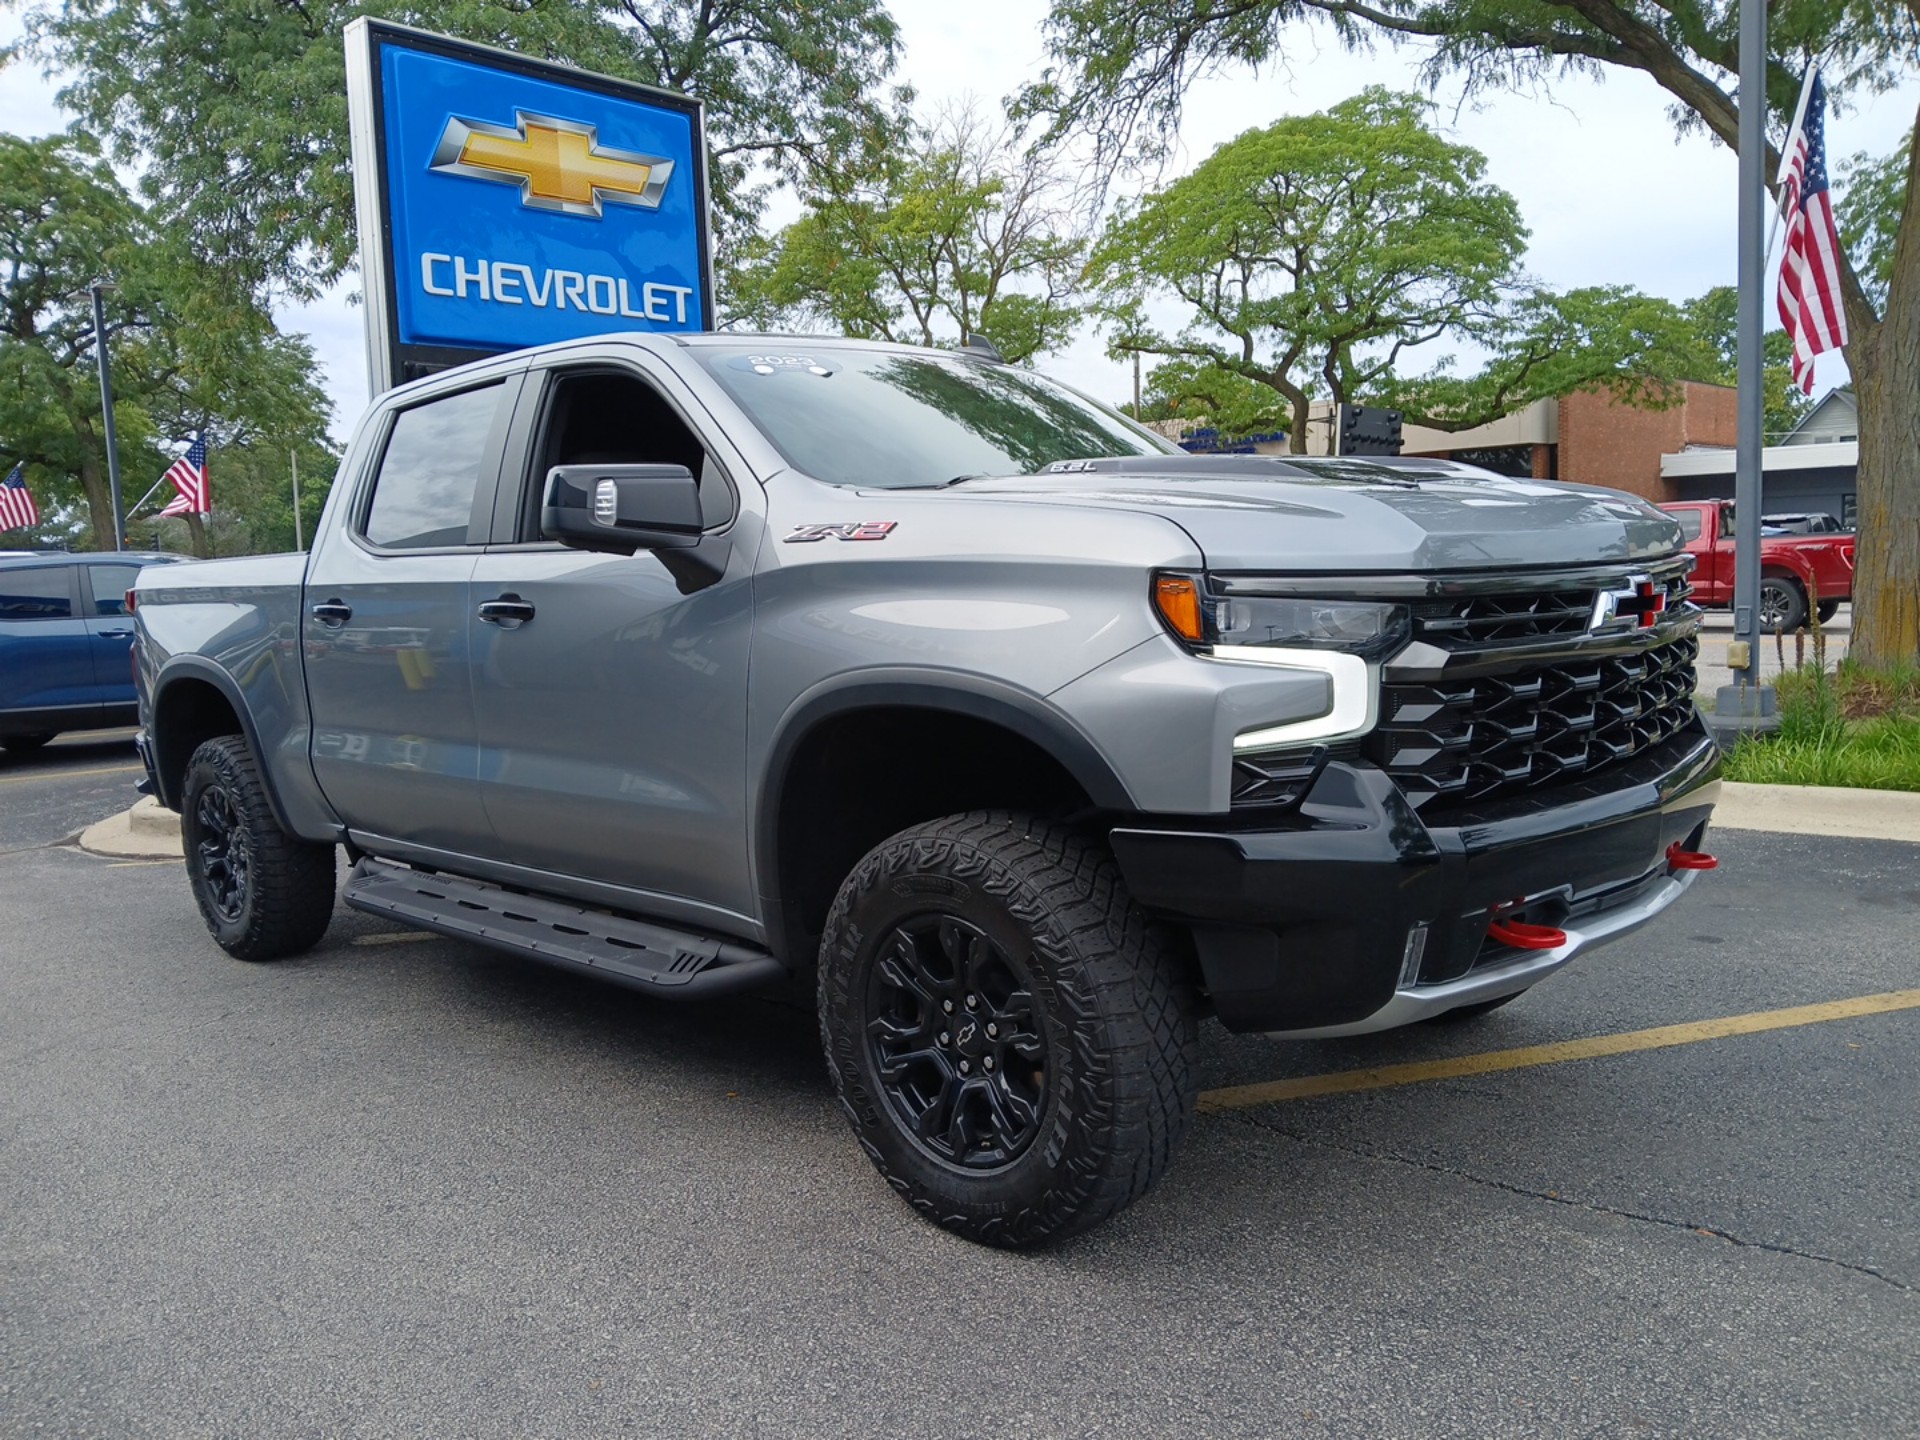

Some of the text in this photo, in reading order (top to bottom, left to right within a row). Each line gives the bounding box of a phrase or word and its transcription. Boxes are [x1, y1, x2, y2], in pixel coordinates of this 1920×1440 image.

[421, 252, 693, 323] CHEVROLET
[748, 354, 817, 366] 2023
[1050, 461, 1097, 473] 6.2L
[783, 520, 898, 543] ZR2
